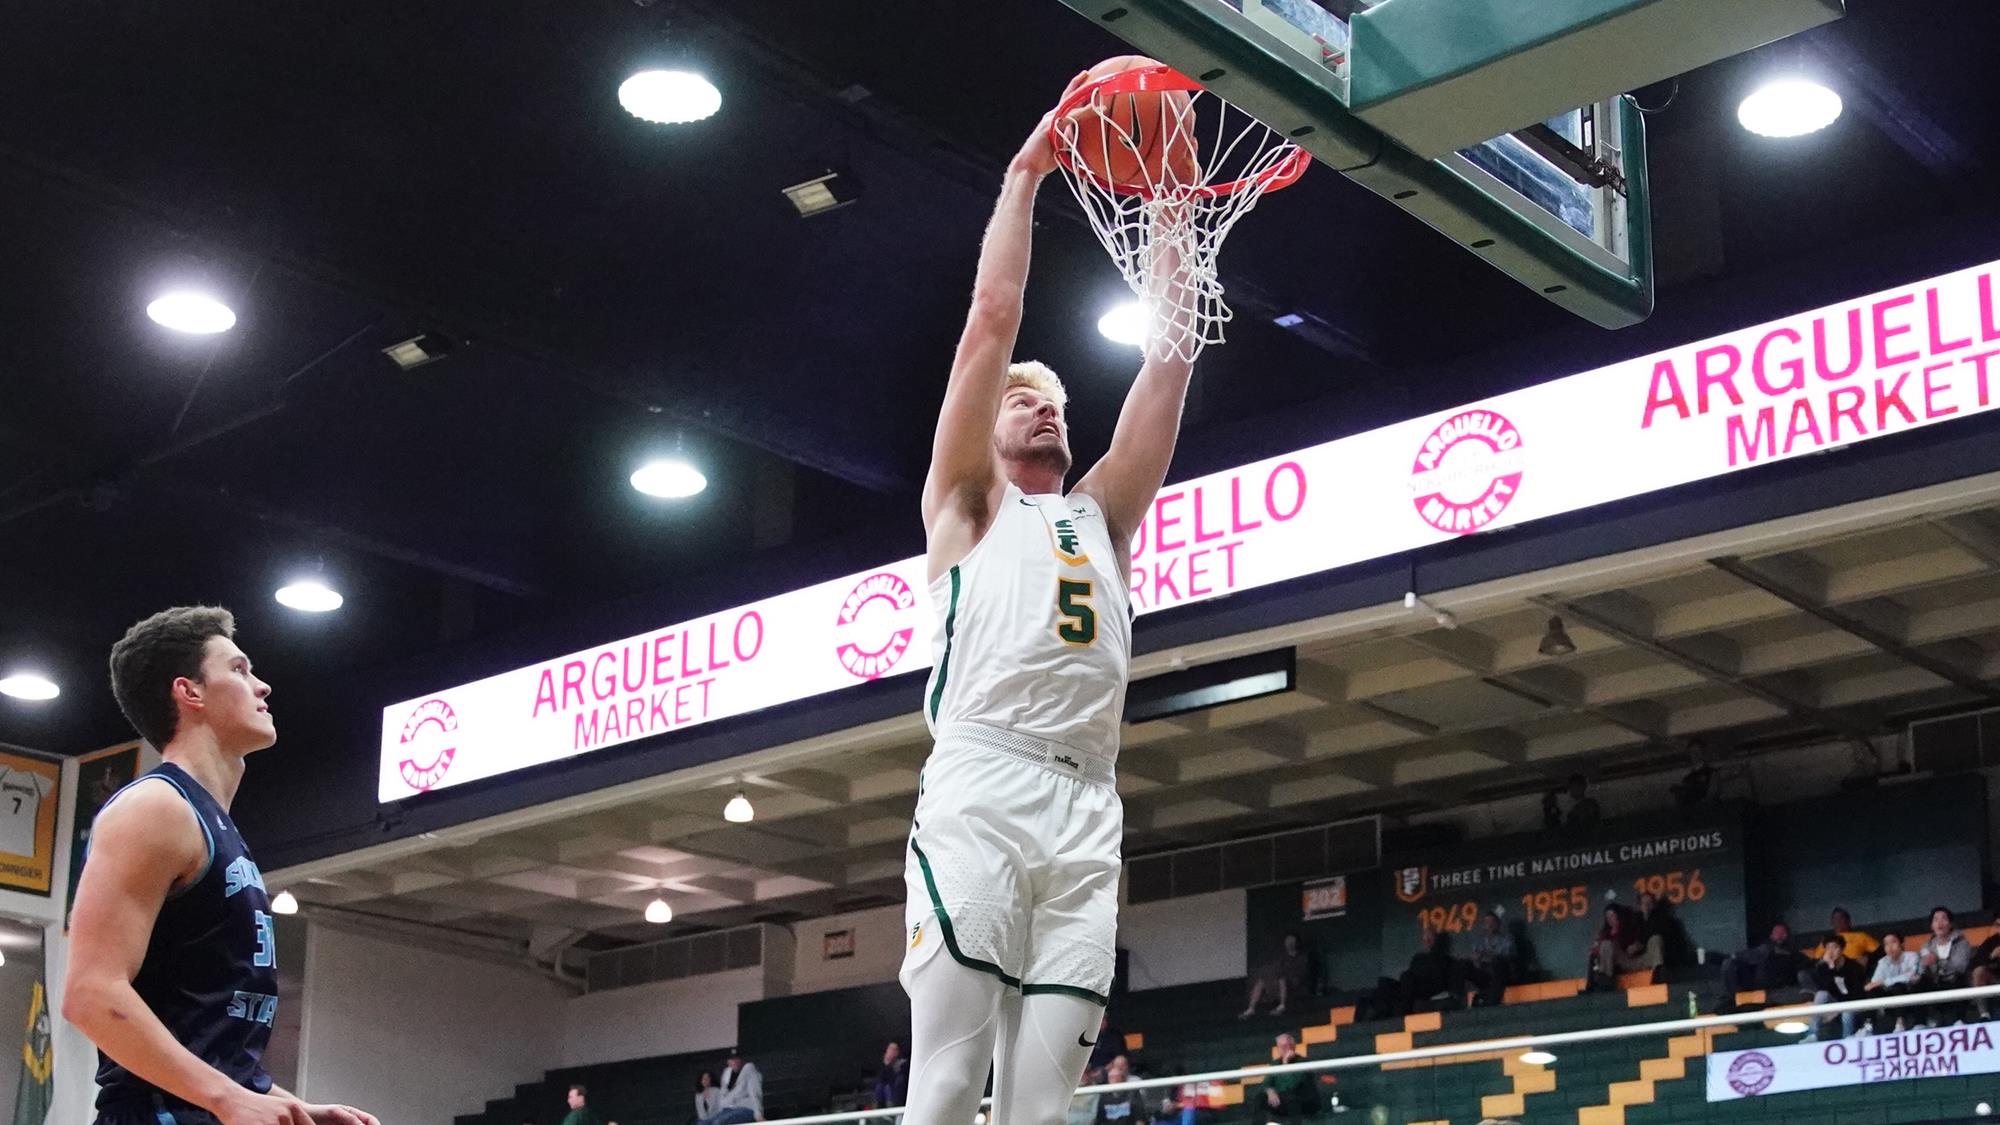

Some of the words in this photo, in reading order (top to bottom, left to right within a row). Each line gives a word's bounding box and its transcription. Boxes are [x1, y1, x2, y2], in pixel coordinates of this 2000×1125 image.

[1641, 273, 2000, 429] ARGUELL
[1727, 350, 2000, 467] MARKET
[1416, 410, 1521, 471] ARGUELLO
[1417, 478, 1515, 532] MARKET
[1057, 578, 1097, 647] 5
[532, 610, 763, 718] ARGUELLO
[574, 678, 716, 750] MARKET
[12, 796, 22, 814] 7
[1431, 868, 1481, 890] THREE
[1489, 862, 1525, 881] TIME
[1532, 850, 1614, 874] NATIONAL
[1620, 832, 1723, 862] CHAMPIONS
[1633, 869, 1706, 905] 1956
[1417, 901, 1479, 933] 1949
[1522, 885, 1588, 923] 1955
